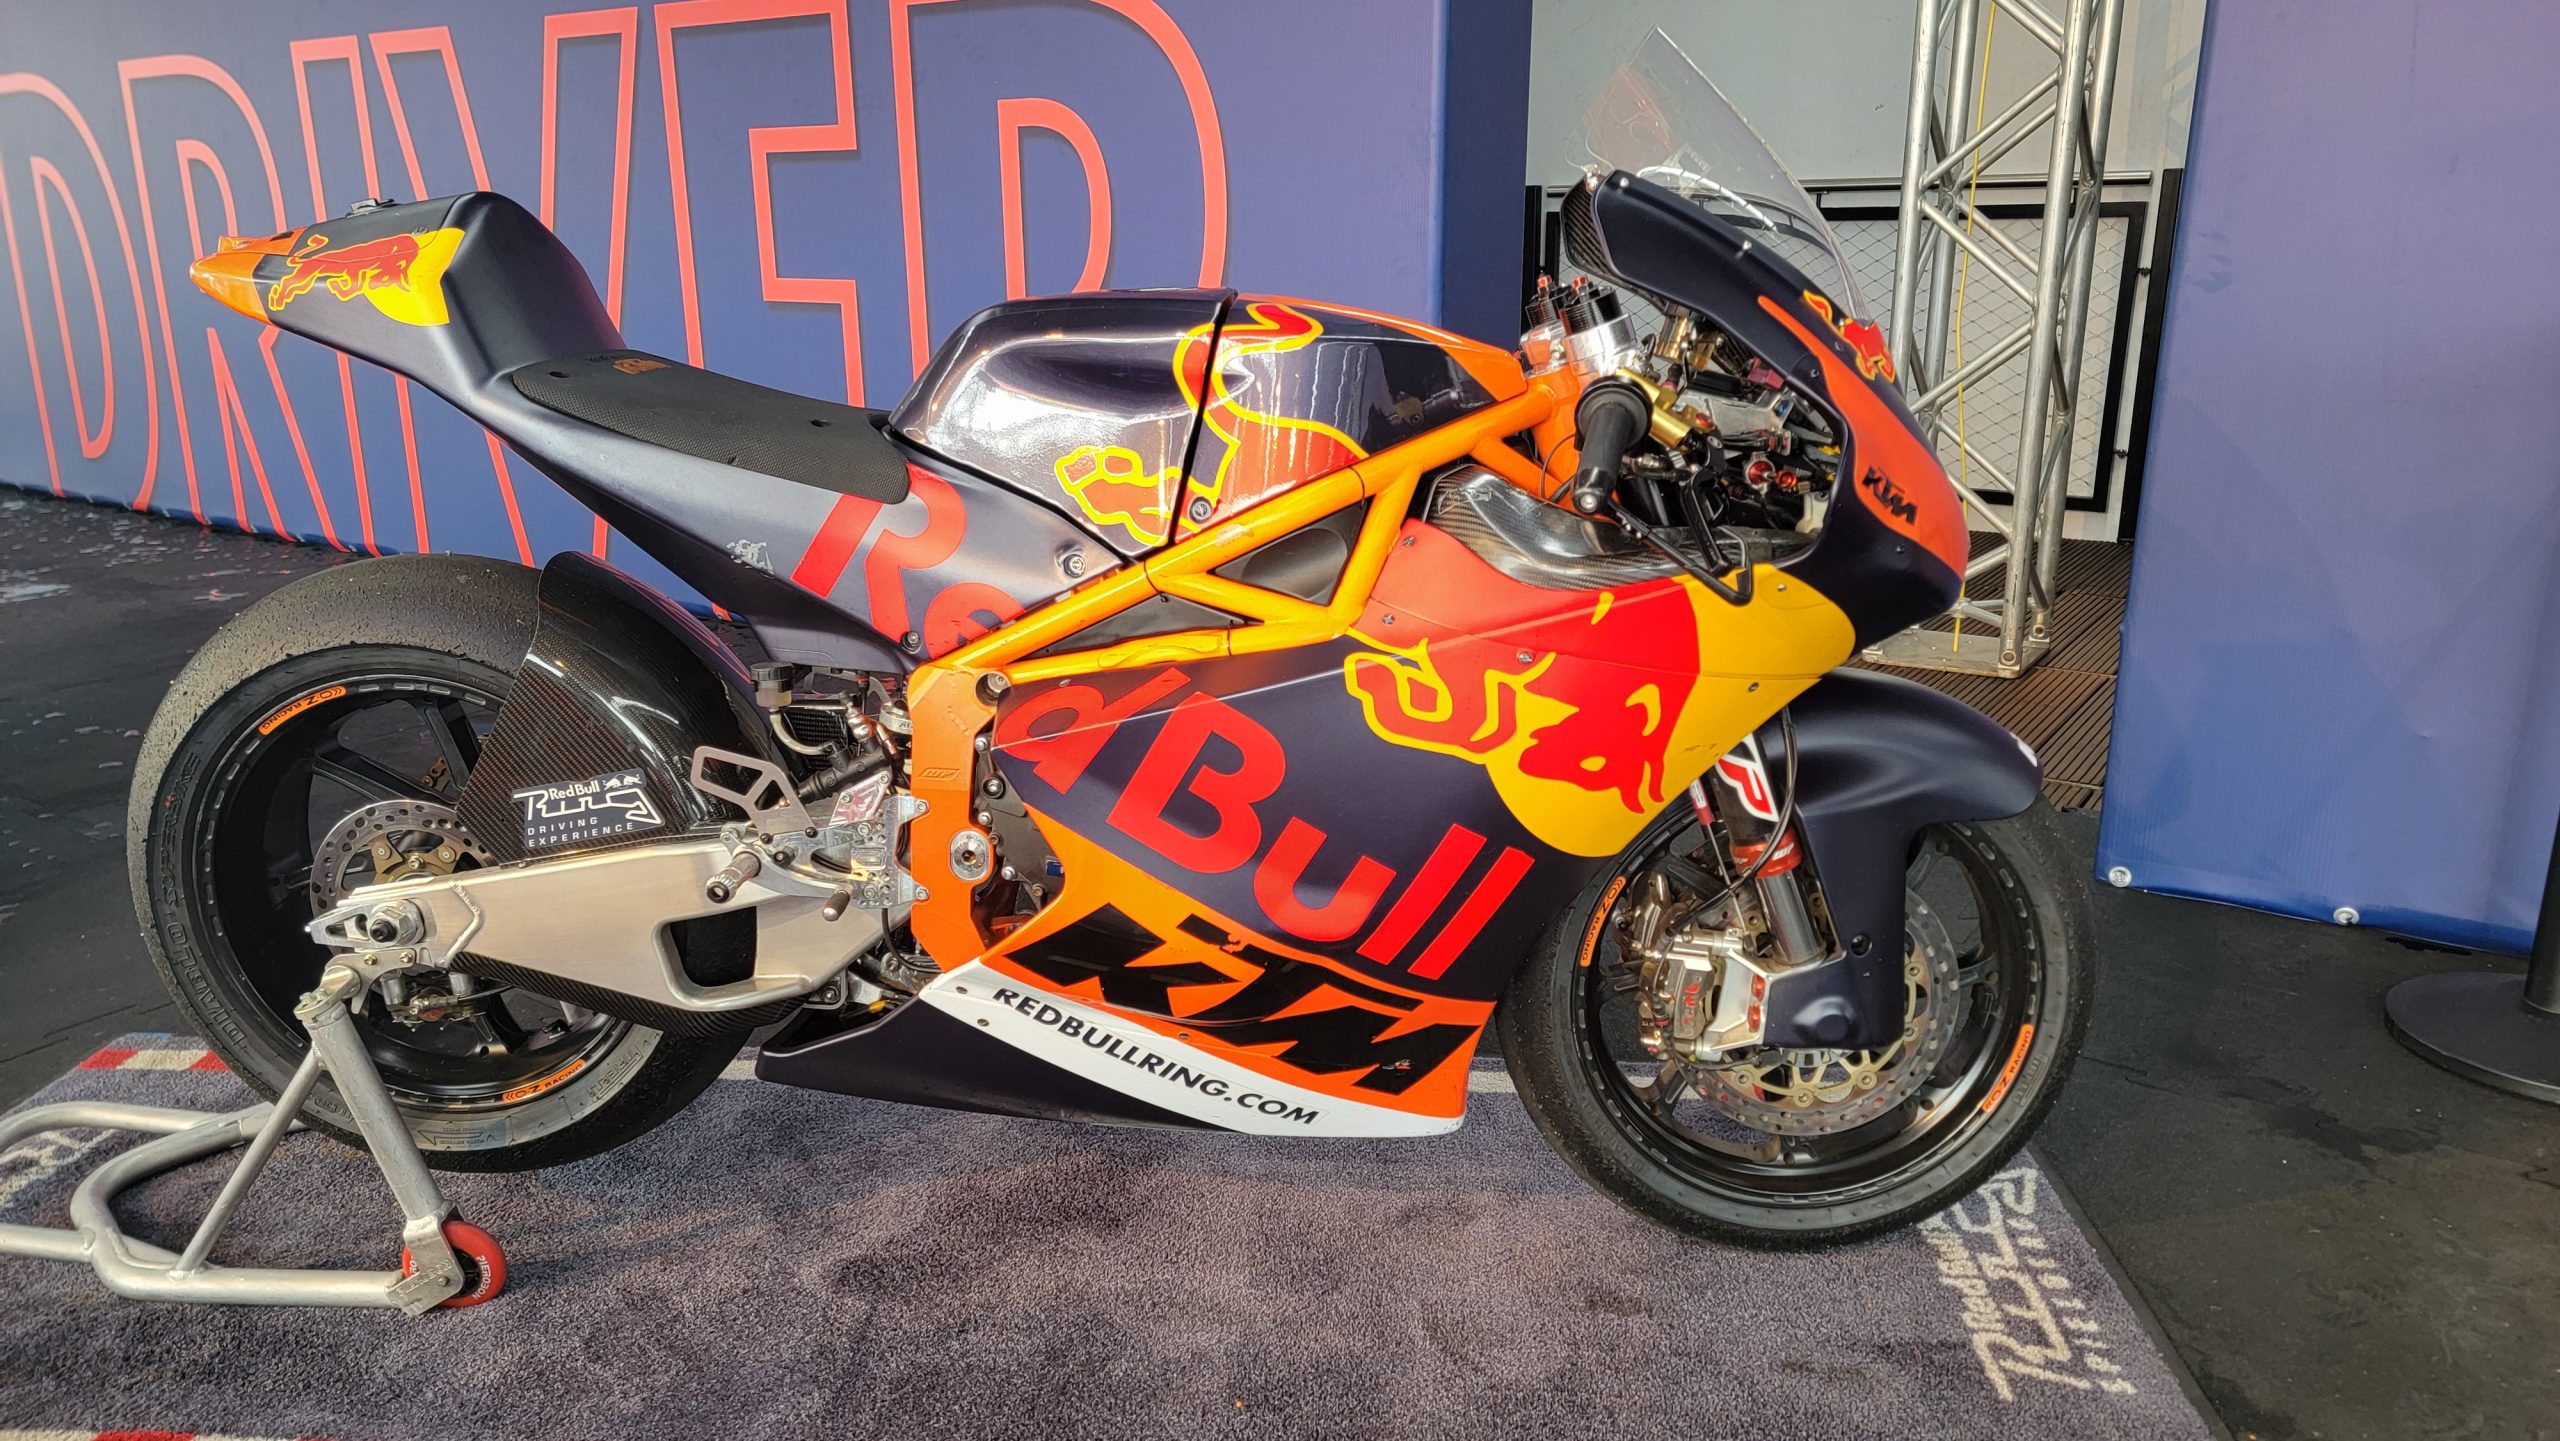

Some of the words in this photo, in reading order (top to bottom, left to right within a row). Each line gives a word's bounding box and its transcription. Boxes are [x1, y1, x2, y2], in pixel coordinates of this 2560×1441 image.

[1862, 466, 1919, 527] KTM
[262, 703, 302, 730] RACING
[549, 783, 575, 801] Red
[575, 779, 601, 796] Bull
[527, 816, 599, 836] DRIVING
[528, 822, 634, 847] EXPERIENCE
[1106, 691, 1535, 981] Bull
[1582, 916, 1600, 961] RACING
[166, 921, 248, 1047] DIABLO
[1003, 905, 1482, 1096] KTM
[992, 986, 1320, 1126] REDBULLRING.COM
[2010, 1030, 2031, 1073] RACING
[545, 1063, 584, 1088] RACING
